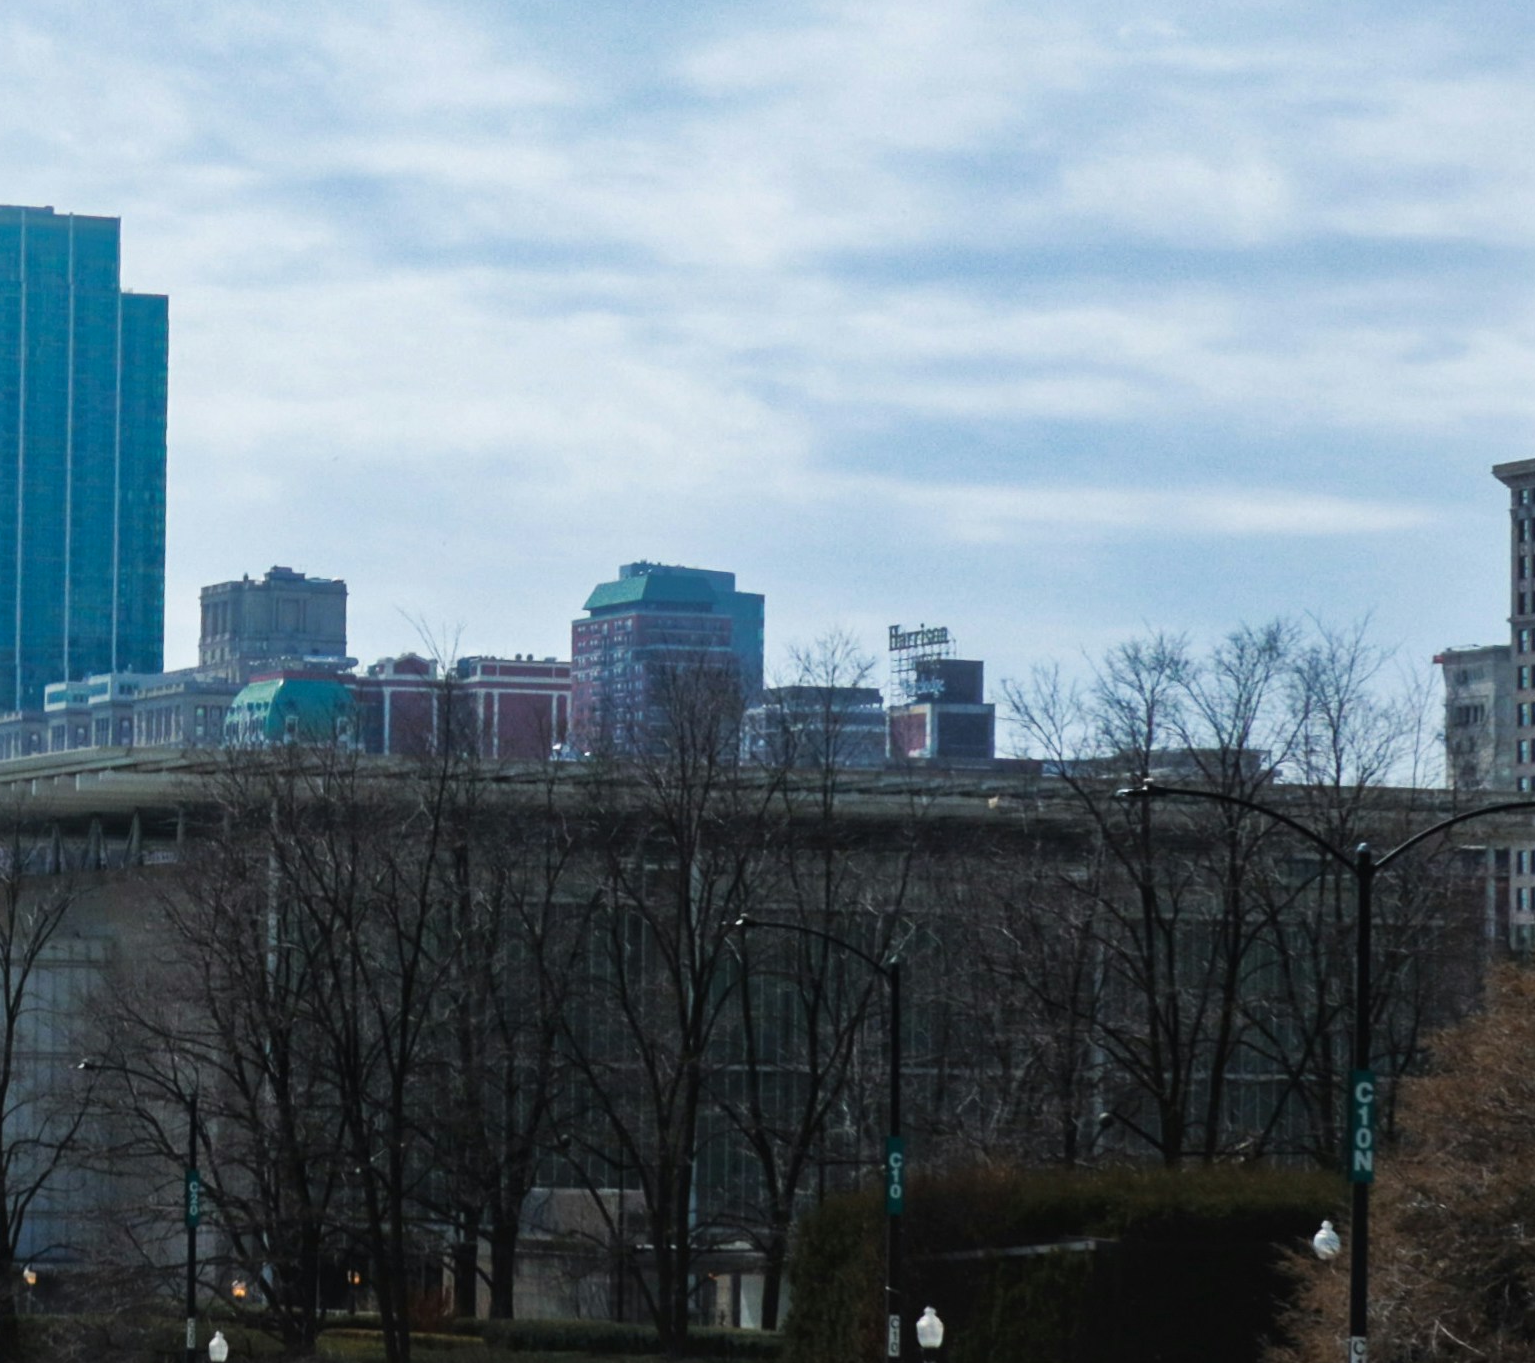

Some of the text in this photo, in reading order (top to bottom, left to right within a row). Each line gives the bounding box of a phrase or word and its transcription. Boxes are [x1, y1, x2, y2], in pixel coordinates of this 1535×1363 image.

[889, 623, 948, 651] Harrison
[1355, 1082, 1373, 1172] C10N
[889, 1152, 902, 1199] C10
